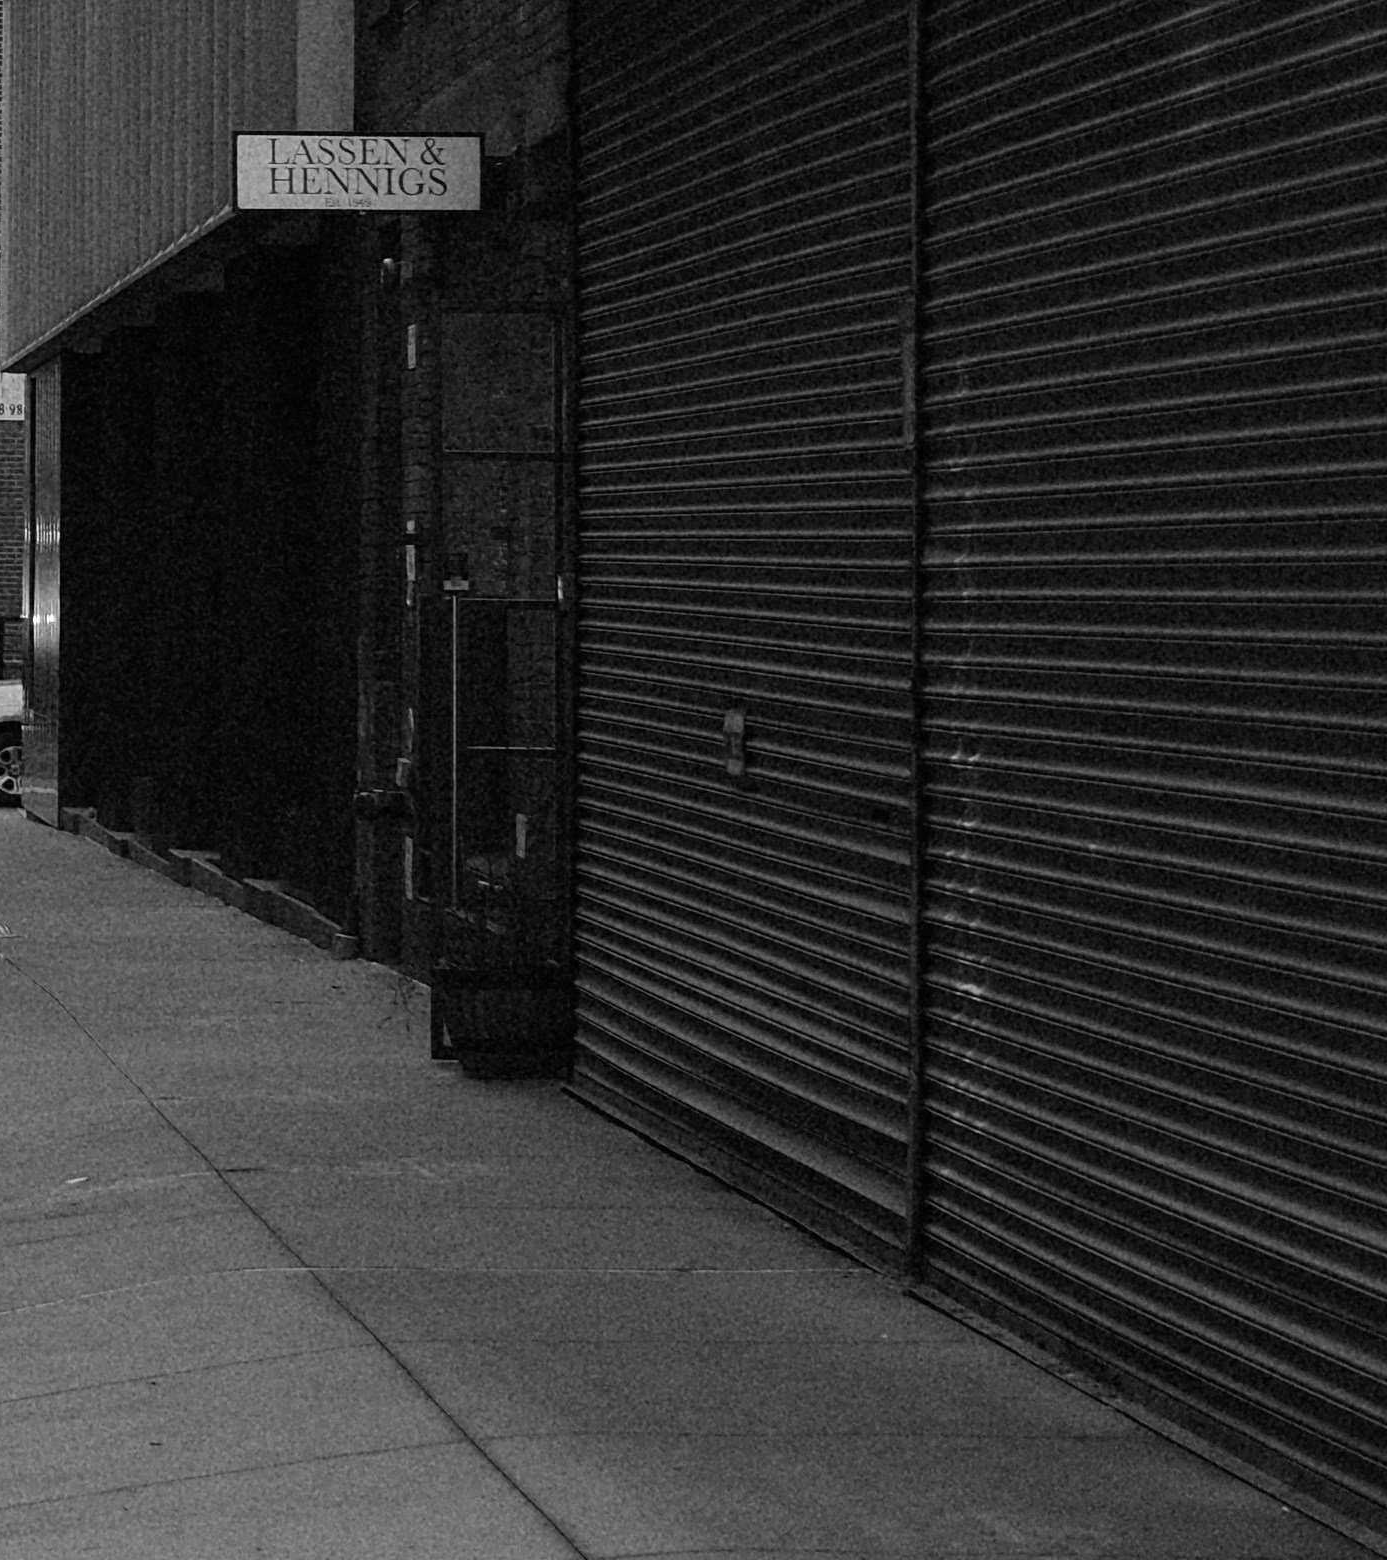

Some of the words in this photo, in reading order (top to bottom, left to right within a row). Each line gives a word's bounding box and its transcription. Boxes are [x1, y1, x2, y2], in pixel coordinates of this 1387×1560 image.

[268, 137, 411, 165] LASSEN
[420, 137, 446, 166] &
[268, 167, 448, 196] HENNIGS
